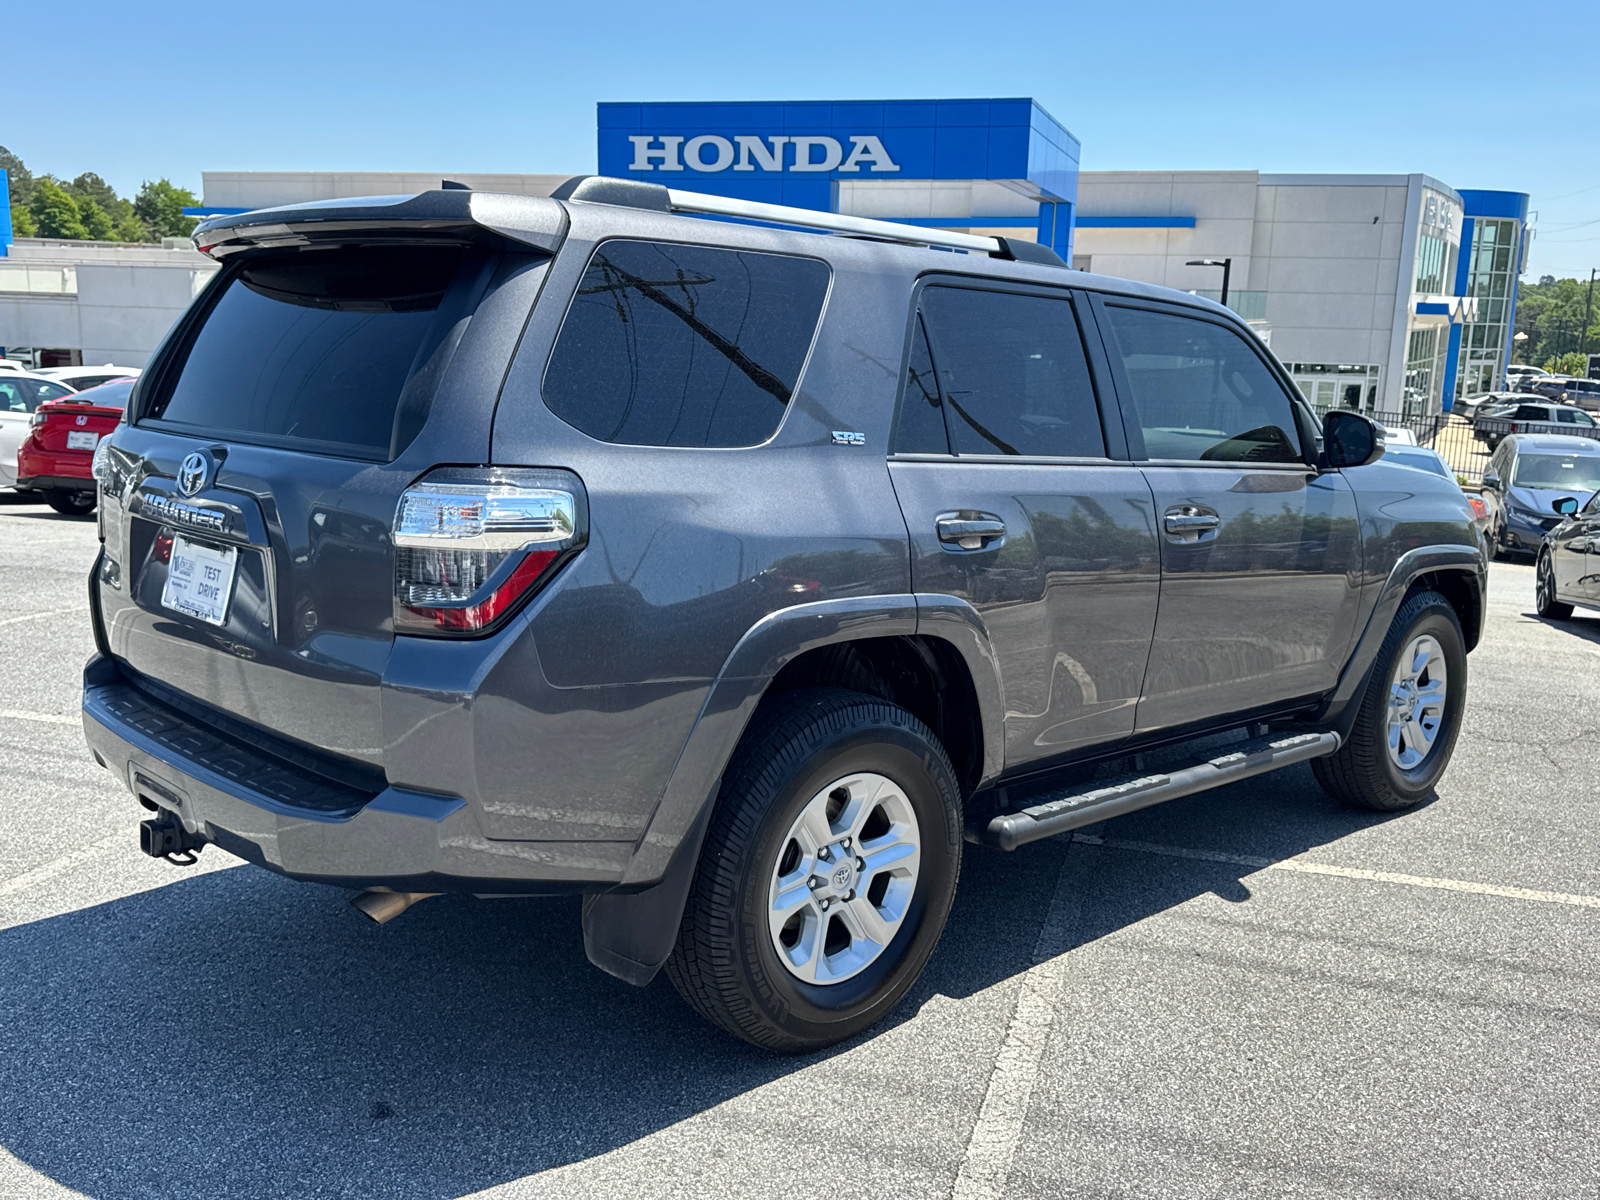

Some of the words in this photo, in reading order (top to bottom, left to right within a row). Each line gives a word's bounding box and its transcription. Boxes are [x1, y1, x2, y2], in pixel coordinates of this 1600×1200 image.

[628, 134, 900, 173] HONDA
[831, 430, 866, 446] SR5
[141, 493, 226, 532] 4RUNNER
[197, 582, 221, 601] DRIVE
[204, 565, 222, 583] TEST
[937, 776, 958, 846] MICHELIN
[744, 926, 773, 1000] MICHELIN
